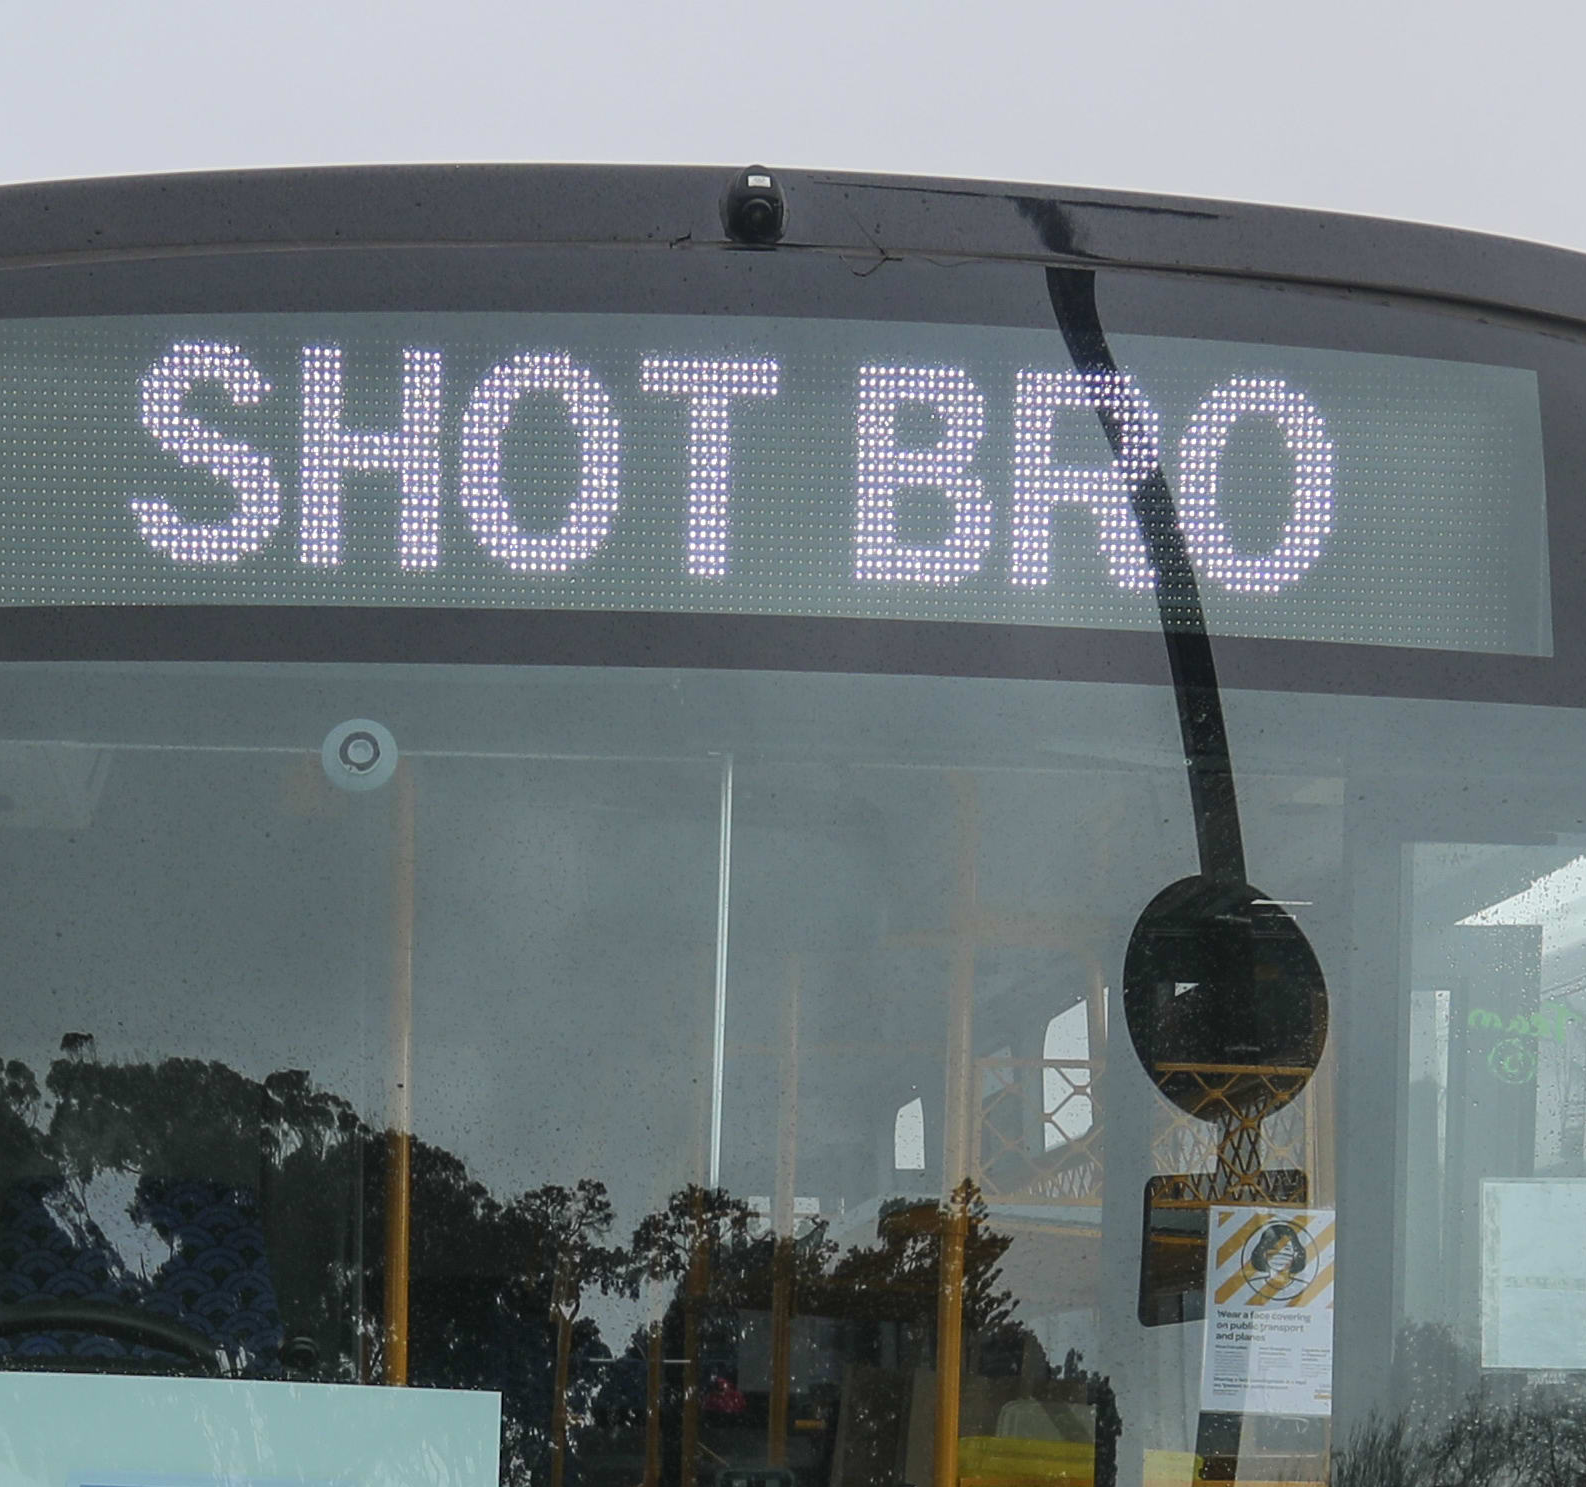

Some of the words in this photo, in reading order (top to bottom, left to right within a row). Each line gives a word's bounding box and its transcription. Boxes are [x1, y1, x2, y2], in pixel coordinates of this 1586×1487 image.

[129, 339, 781, 577] SHOT
[853, 361, 1340, 595] BRO
[1217, 1310, 1241, 1319] Wear
[1250, 1311, 1270, 1320] face
[1271, 1312, 1311, 1323] covering
[1230, 1320, 1259, 1331] public
[1260, 1323, 1304, 1333] transport
[1216, 1332, 1234, 1340] and
[1235, 1333, 1266, 1342] planes
